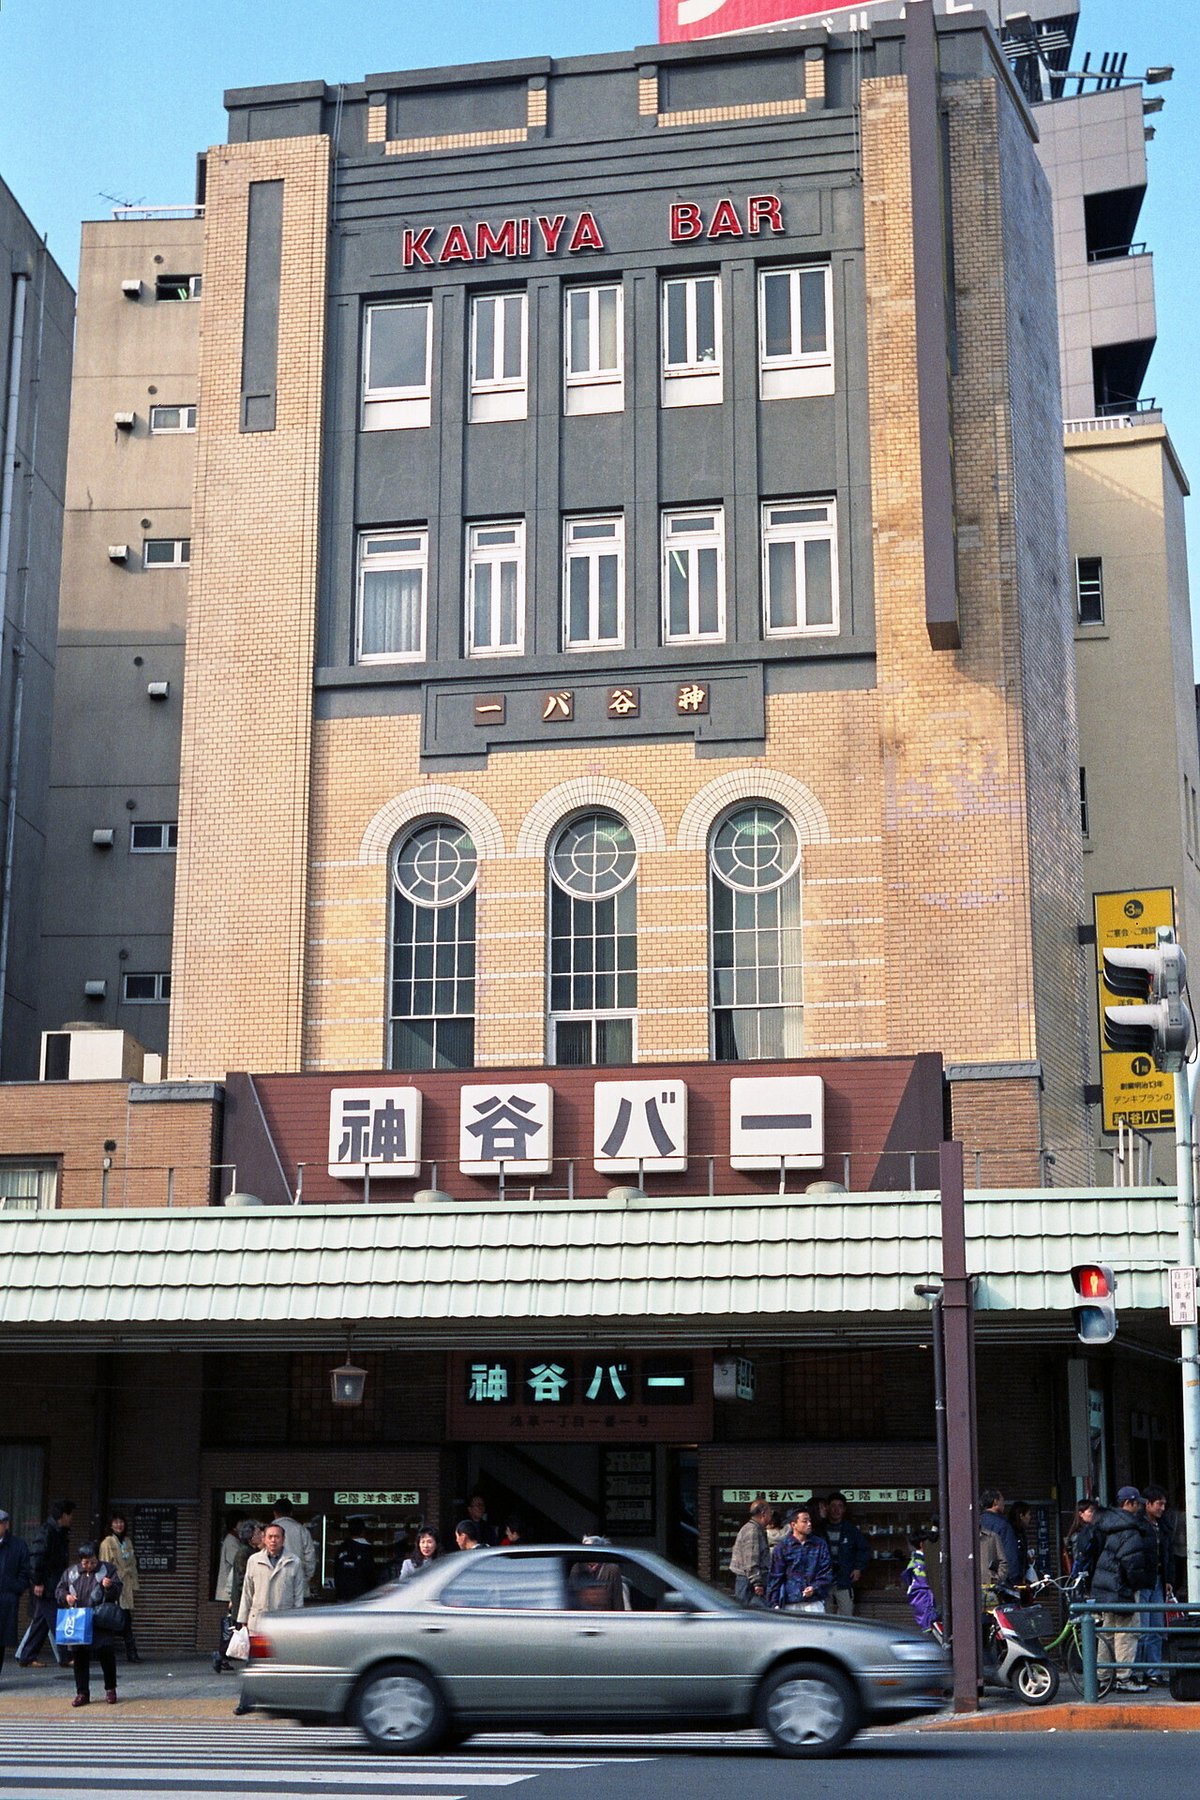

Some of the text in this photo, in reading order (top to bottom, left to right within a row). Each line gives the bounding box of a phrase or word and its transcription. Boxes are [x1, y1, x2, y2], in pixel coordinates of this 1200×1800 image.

[402, 194, 786, 267] KAMIYA BAR
[338, 1091, 812, 1162] 神谷バー
[469, 1363, 685, 1401] 神谷バー
